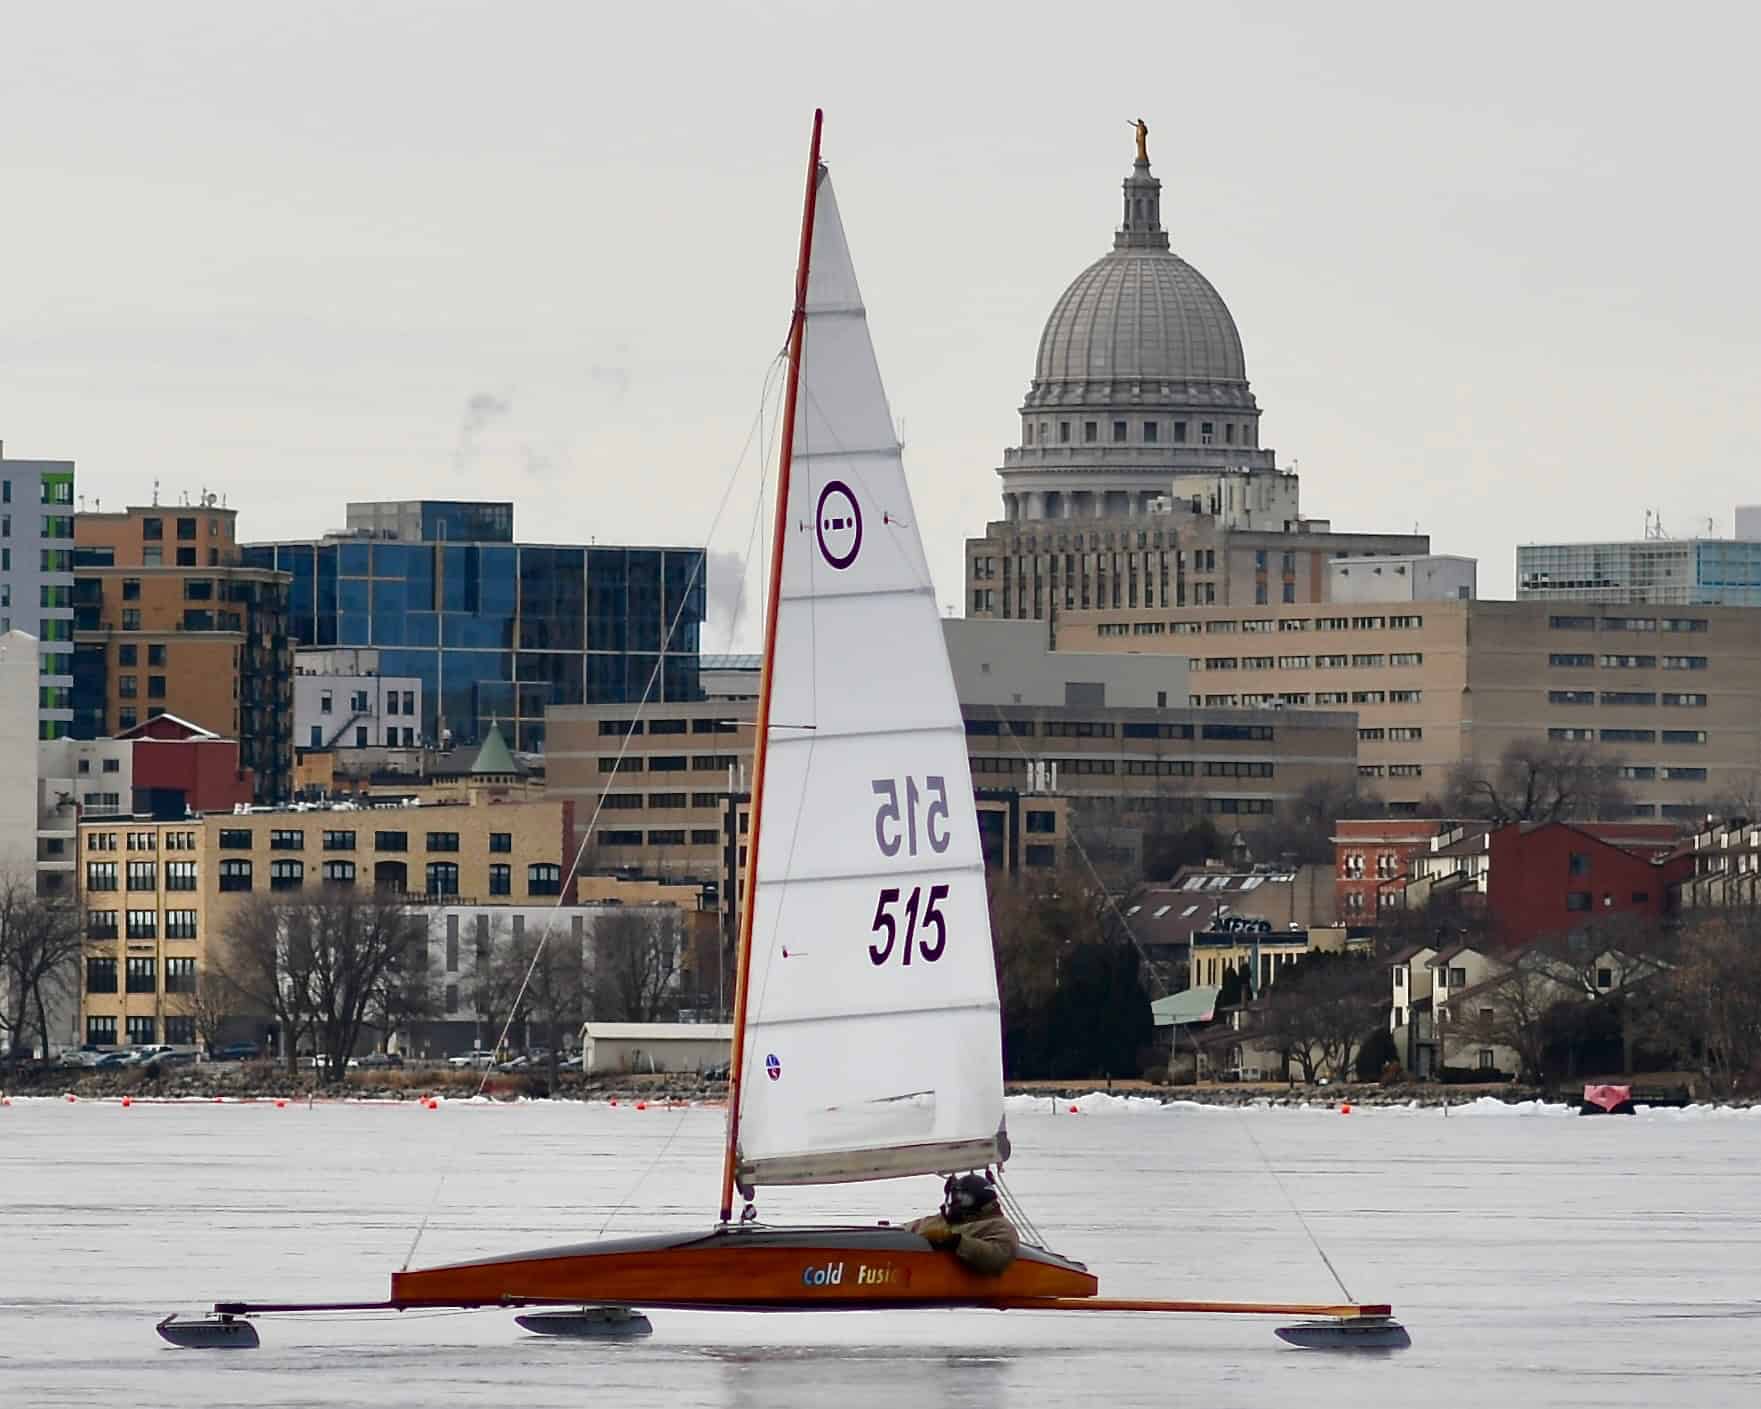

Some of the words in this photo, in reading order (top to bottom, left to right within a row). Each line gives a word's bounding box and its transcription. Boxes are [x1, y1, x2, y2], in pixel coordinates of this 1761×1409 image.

[868, 884, 950, 966] 515
[803, 1262, 844, 1285] Cold
[857, 1262, 912, 1285] Fusi
